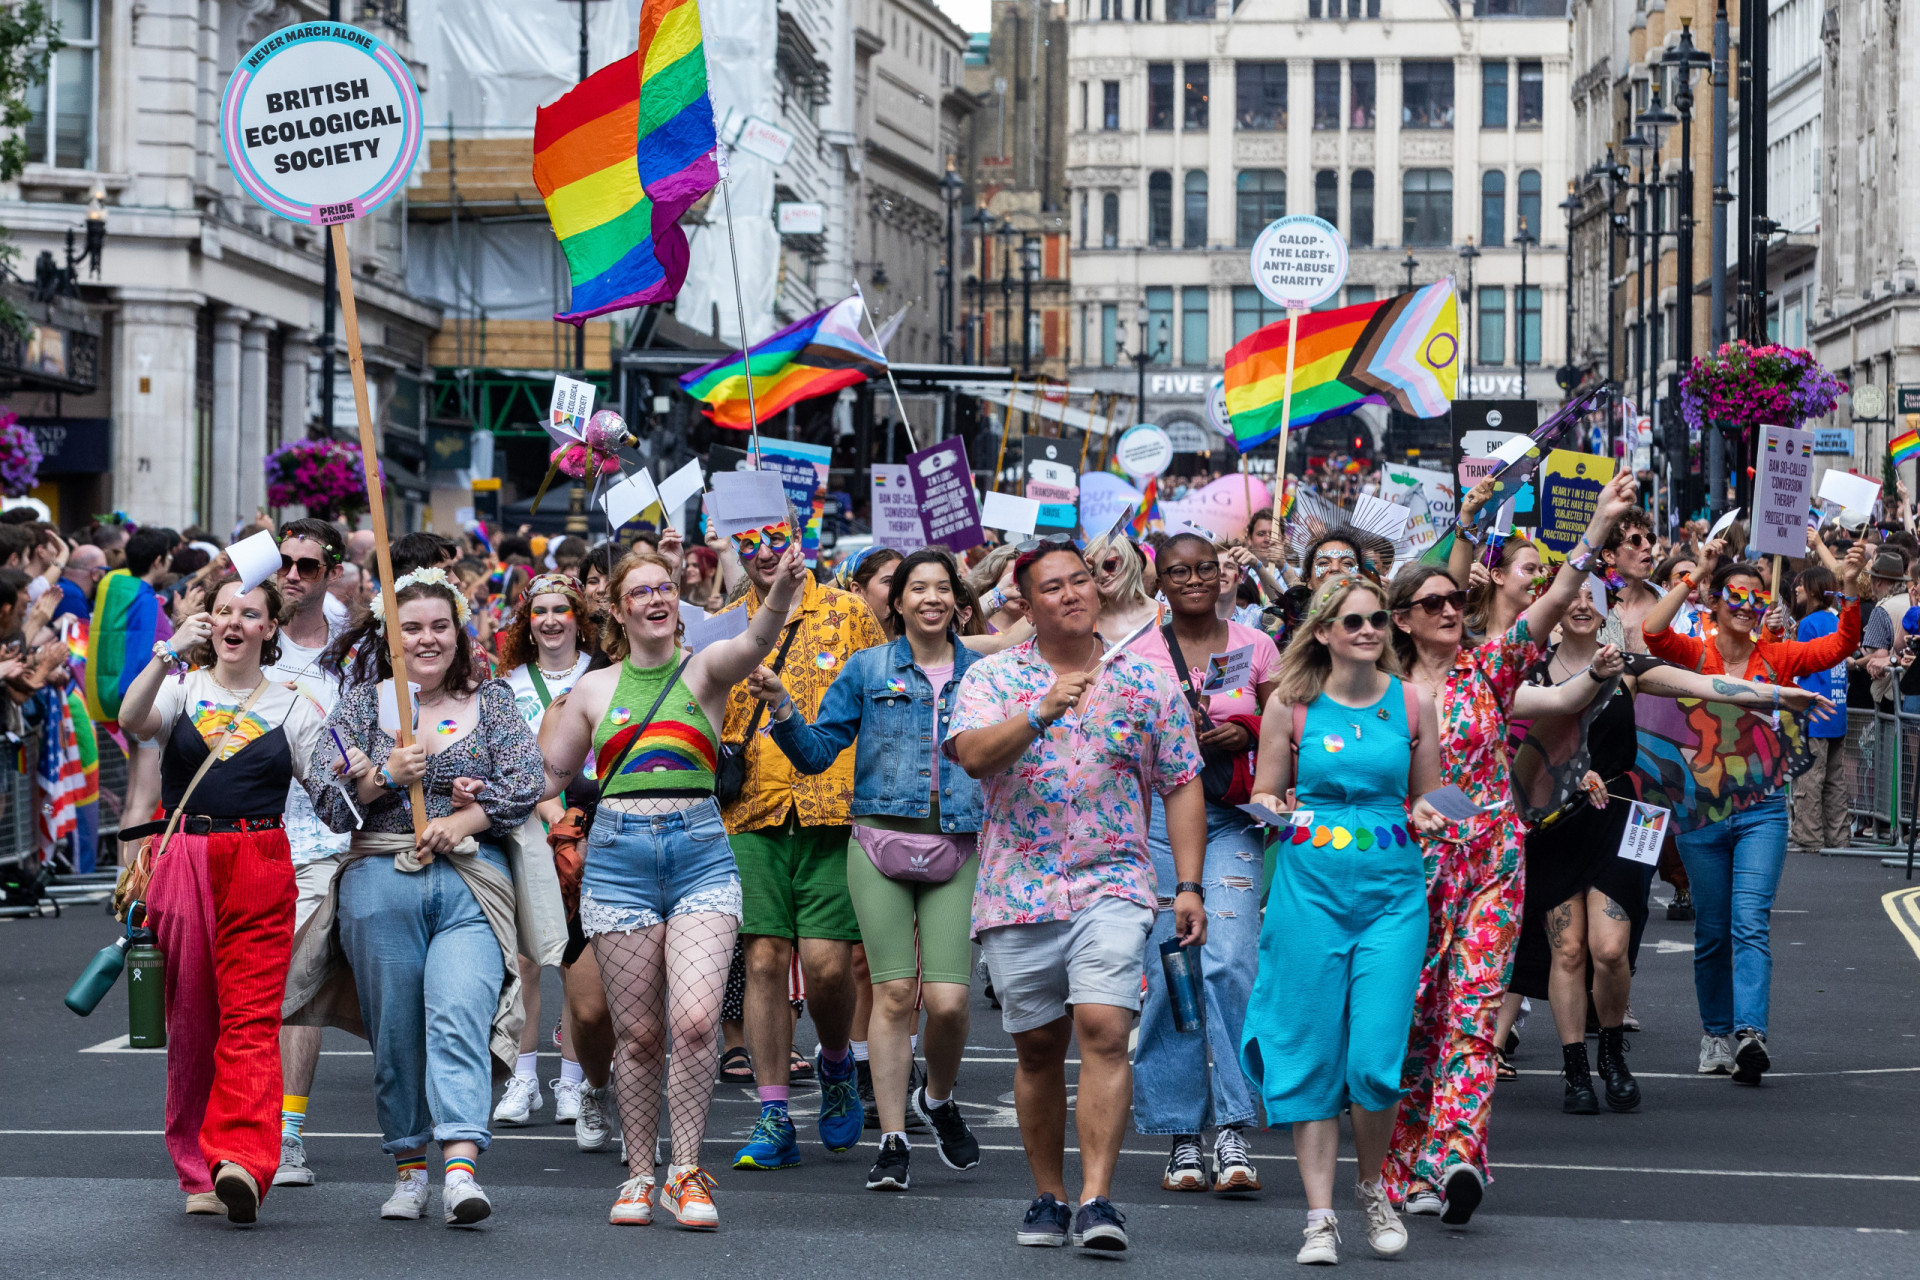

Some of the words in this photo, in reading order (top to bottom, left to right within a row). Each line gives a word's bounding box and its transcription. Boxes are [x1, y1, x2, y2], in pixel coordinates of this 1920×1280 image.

[248, 37, 285, 68] NEVER
[285, 26, 331, 43] MARCH
[332, 27, 373, 49] ALONE
[266, 78, 369, 114] BRITISH
[245, 105, 401, 148] ECOLOGICAL
[274, 138, 380, 174] SOCIETY
[329, 213, 355, 222] LONDON
[1273, 218, 1292, 230] NEVER
[1315, 220, 1333, 232] ALONE
[1279, 235, 1317, 245] GALOP
[1269, 248, 1292, 258] THE
[1295, 250, 1331, 259] LGBT+
[1263, 261, 1335, 273] ANTI-ABUSE
[1272, 275, 1323, 286] CHARITY
[1152, 375, 1204, 393] FIVE
[1462, 375, 1527, 394] GUYS
[557, 389, 566, 410] BRITISH
[567, 384, 579, 413] ECOLOGICAL
[578, 395, 588, 415] SOCIETY
[1238, 459, 1275, 473] FIVE
[1769, 459, 1779, 472] BAN
[1780, 461, 1807, 477] SO-CALLED
[1046, 469, 1057, 480] END
[879, 493, 891, 504] BAN
[1031, 486, 1070, 501] TRANSPHOBIC
[1552, 486, 1571, 497] NEARLY
[1575, 489, 1580, 499] IN
[1552, 497, 1570, 508] PEOPLE
[1571, 499, 1584, 510] HAVE
[1584, 502, 1597, 511] BEEN
[1043, 507, 1060, 518] ABUSE
[1555, 508, 1583, 521] SUBJECTED
[1584, 513, 1590, 522] TO
[1765, 510, 1784, 525] PROTECT
[1785, 514, 1801, 526] VICTIMS
[1555, 520, 1586, 532] CONVERSION
[1543, 529, 1570, 542] PRACTICES
[1571, 533, 1577, 543] IN
[1229, 652, 1243, 663] BRITISH
[1227, 662, 1249, 674] ECOLOGICAL
[1224, 675, 1240, 685] SOCIETY
[1628, 826, 1638, 847] SOCIETY
[1635, 829, 1648, 858] ECOLOGICAL
[1648, 831, 1659, 851] BRITISH
